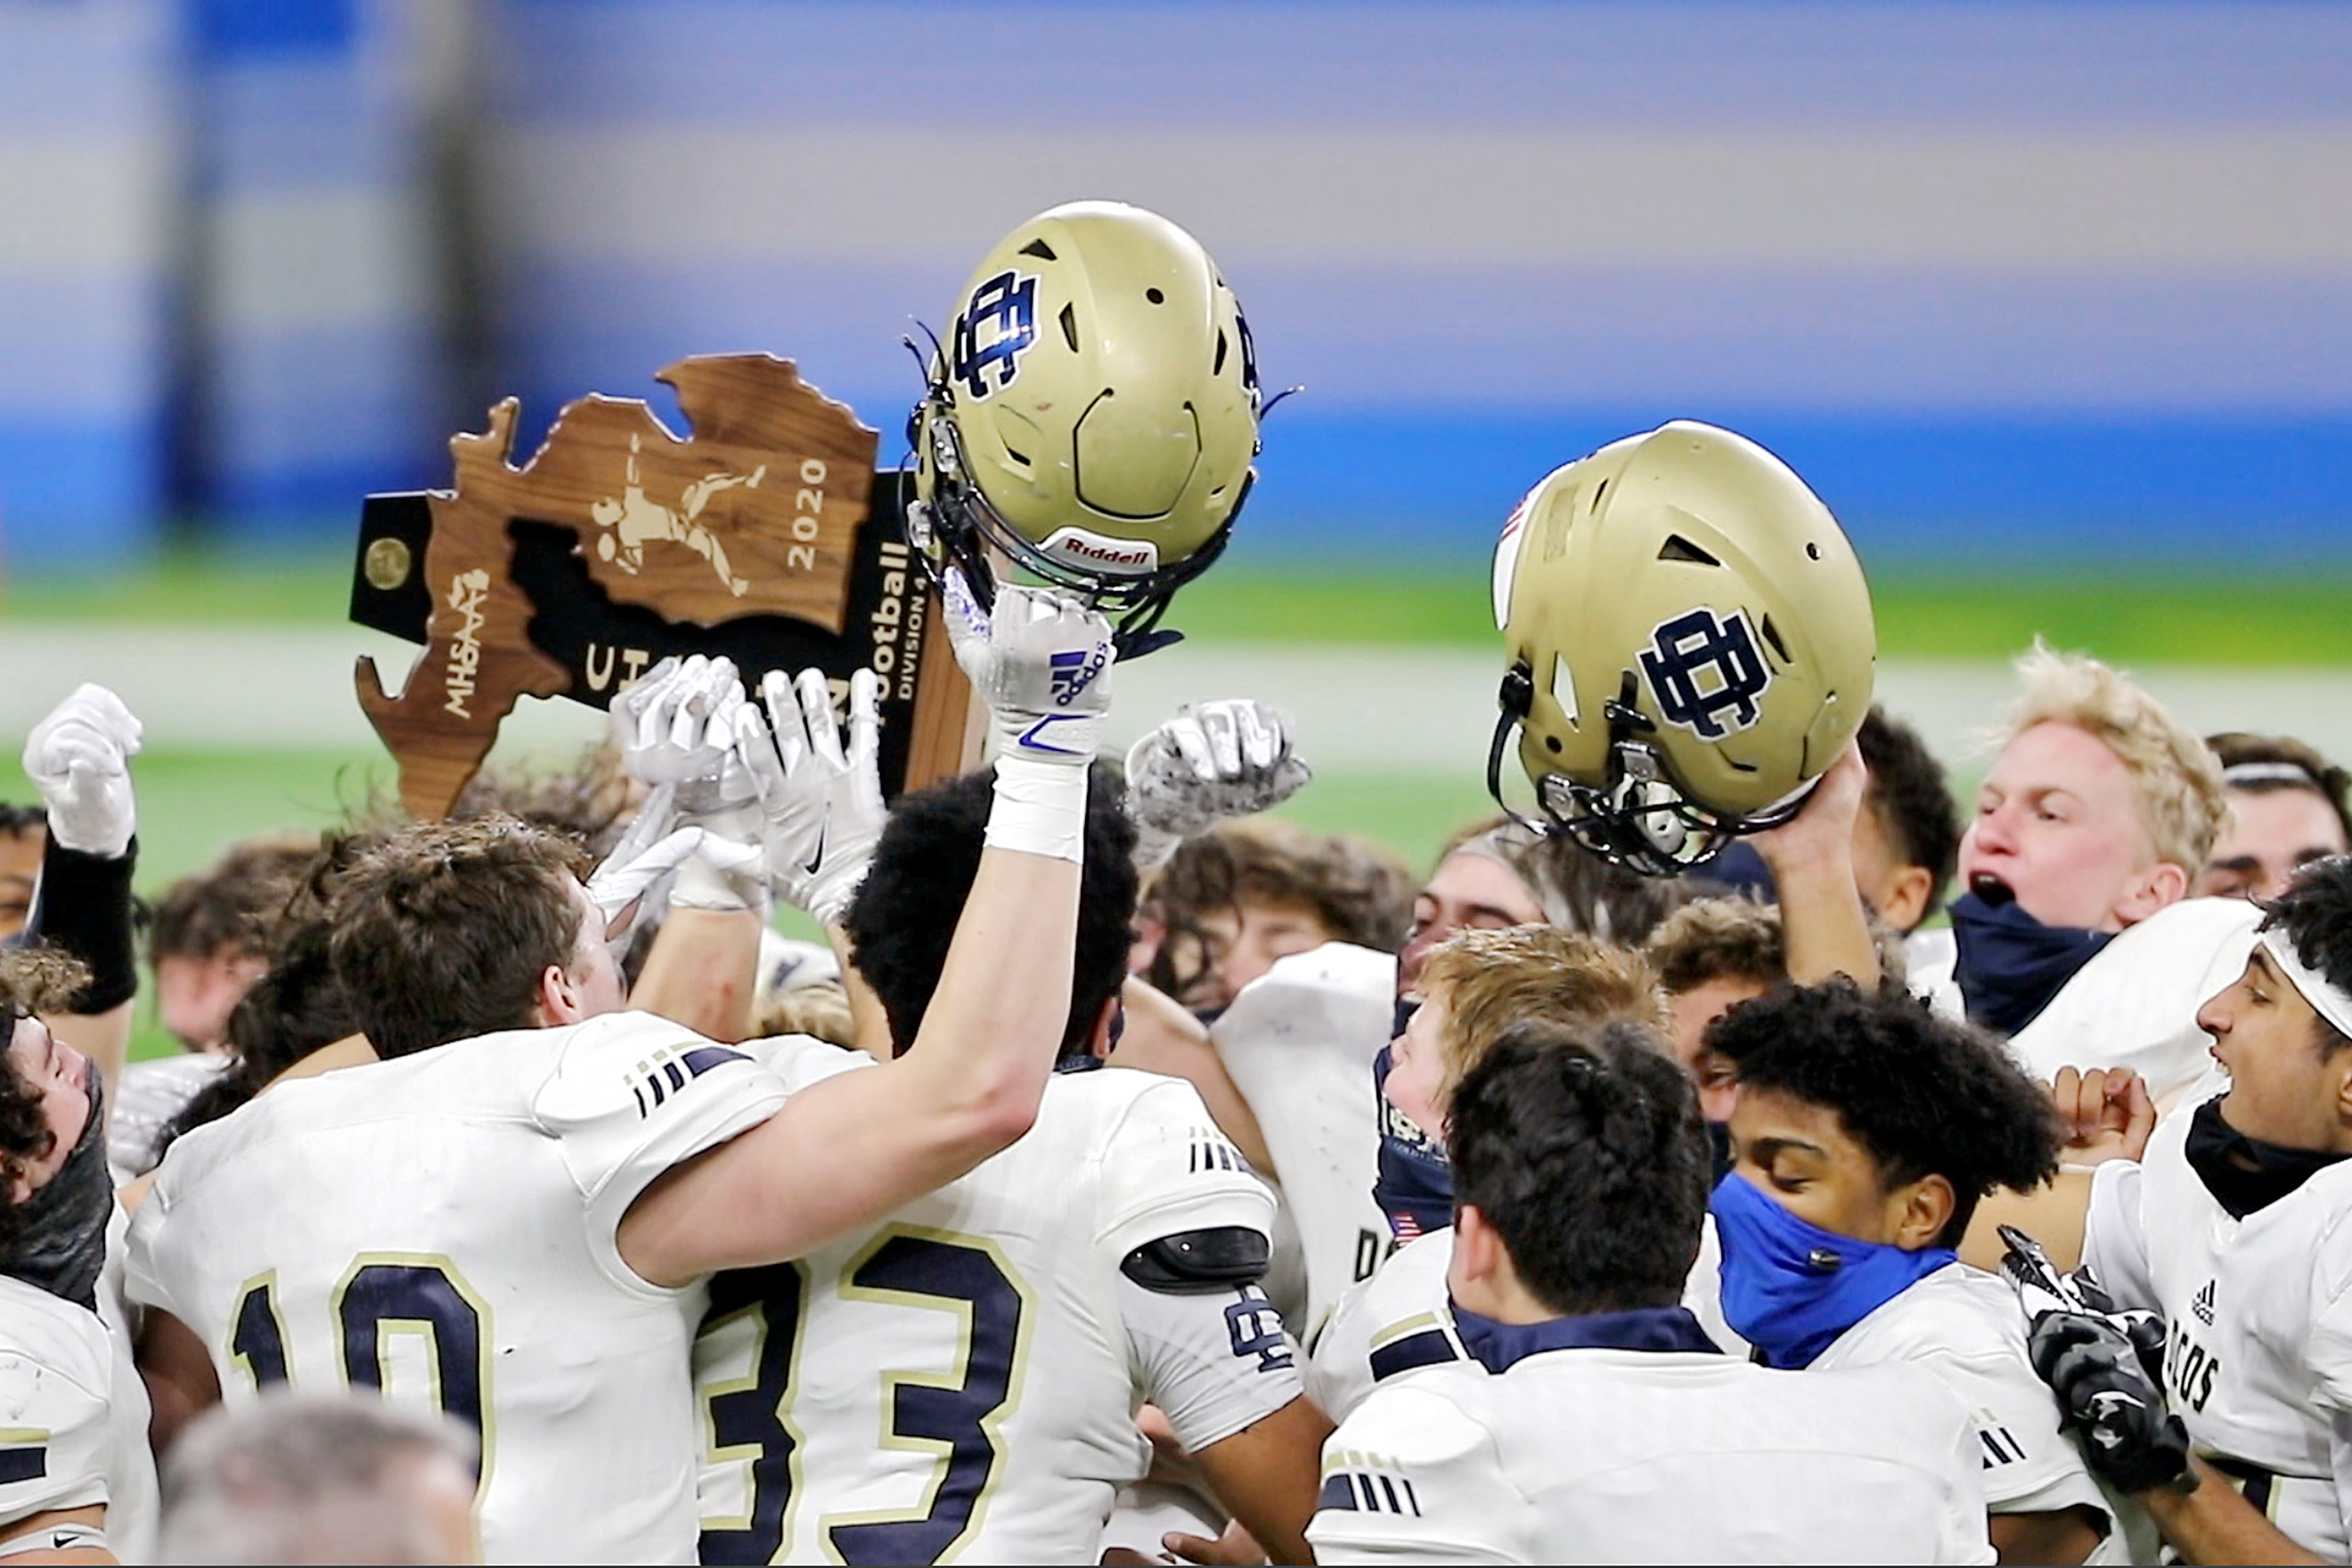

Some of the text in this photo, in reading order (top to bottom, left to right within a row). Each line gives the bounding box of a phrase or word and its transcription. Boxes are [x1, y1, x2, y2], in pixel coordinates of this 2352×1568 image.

[788, 458, 827, 570] 2020
[1065, 537, 1149, 565] Riddell
[444, 589, 488, 720] MHSAA
[870, 541, 910, 727] ootball
[898, 576, 928, 700] DIVISION 4
[1056, 641, 1107, 706] adidas
[225, 1252, 494, 1513] 10
[698, 1221, 1038, 1565] 33
